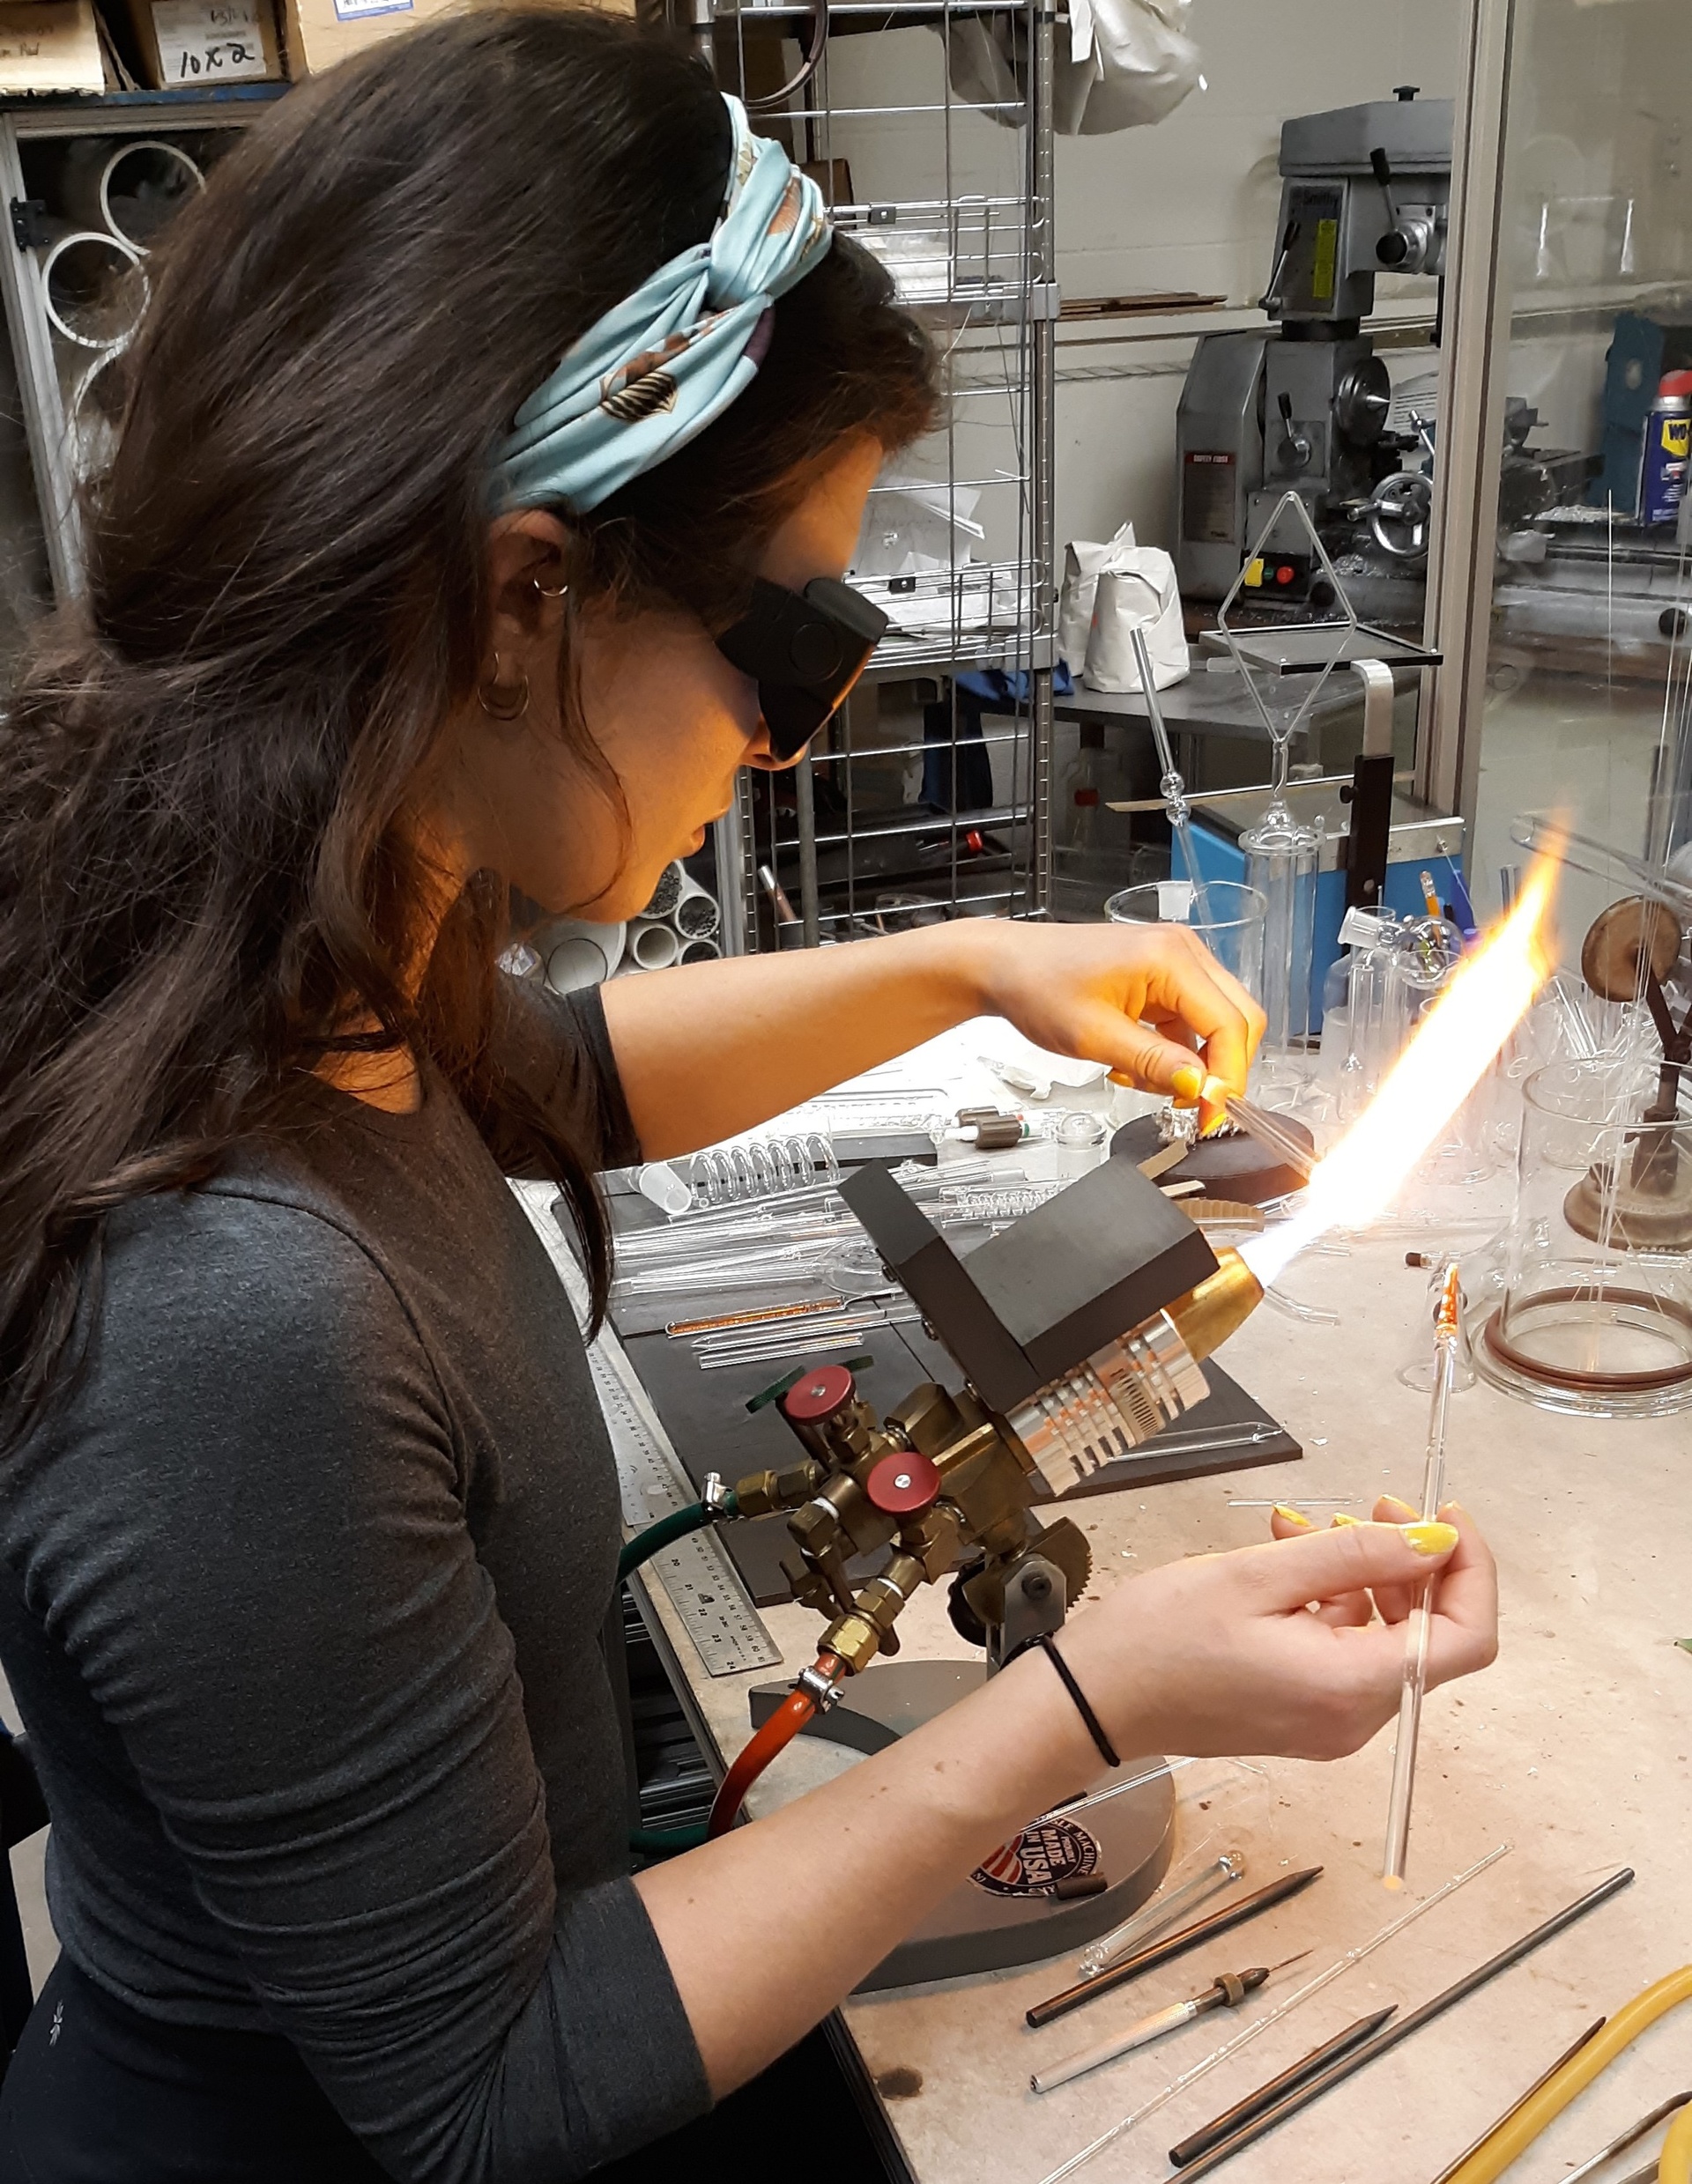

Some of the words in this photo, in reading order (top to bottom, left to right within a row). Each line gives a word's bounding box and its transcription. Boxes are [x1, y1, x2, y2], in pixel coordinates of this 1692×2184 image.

[180, 51, 201, 78] 10
[226, 42, 256, 63] 2
[698, 1608, 708, 1617] 22
[726, 1662, 736, 1670] 24
[1025, 1831, 1042, 1843] IN
[1041, 1829, 1066, 1866] MADE
[1060, 1836, 1076, 1863] PROUDLY
[1072, 1831, 1095, 1876] MACHINE
[1020, 1846, 1053, 1884] USA
